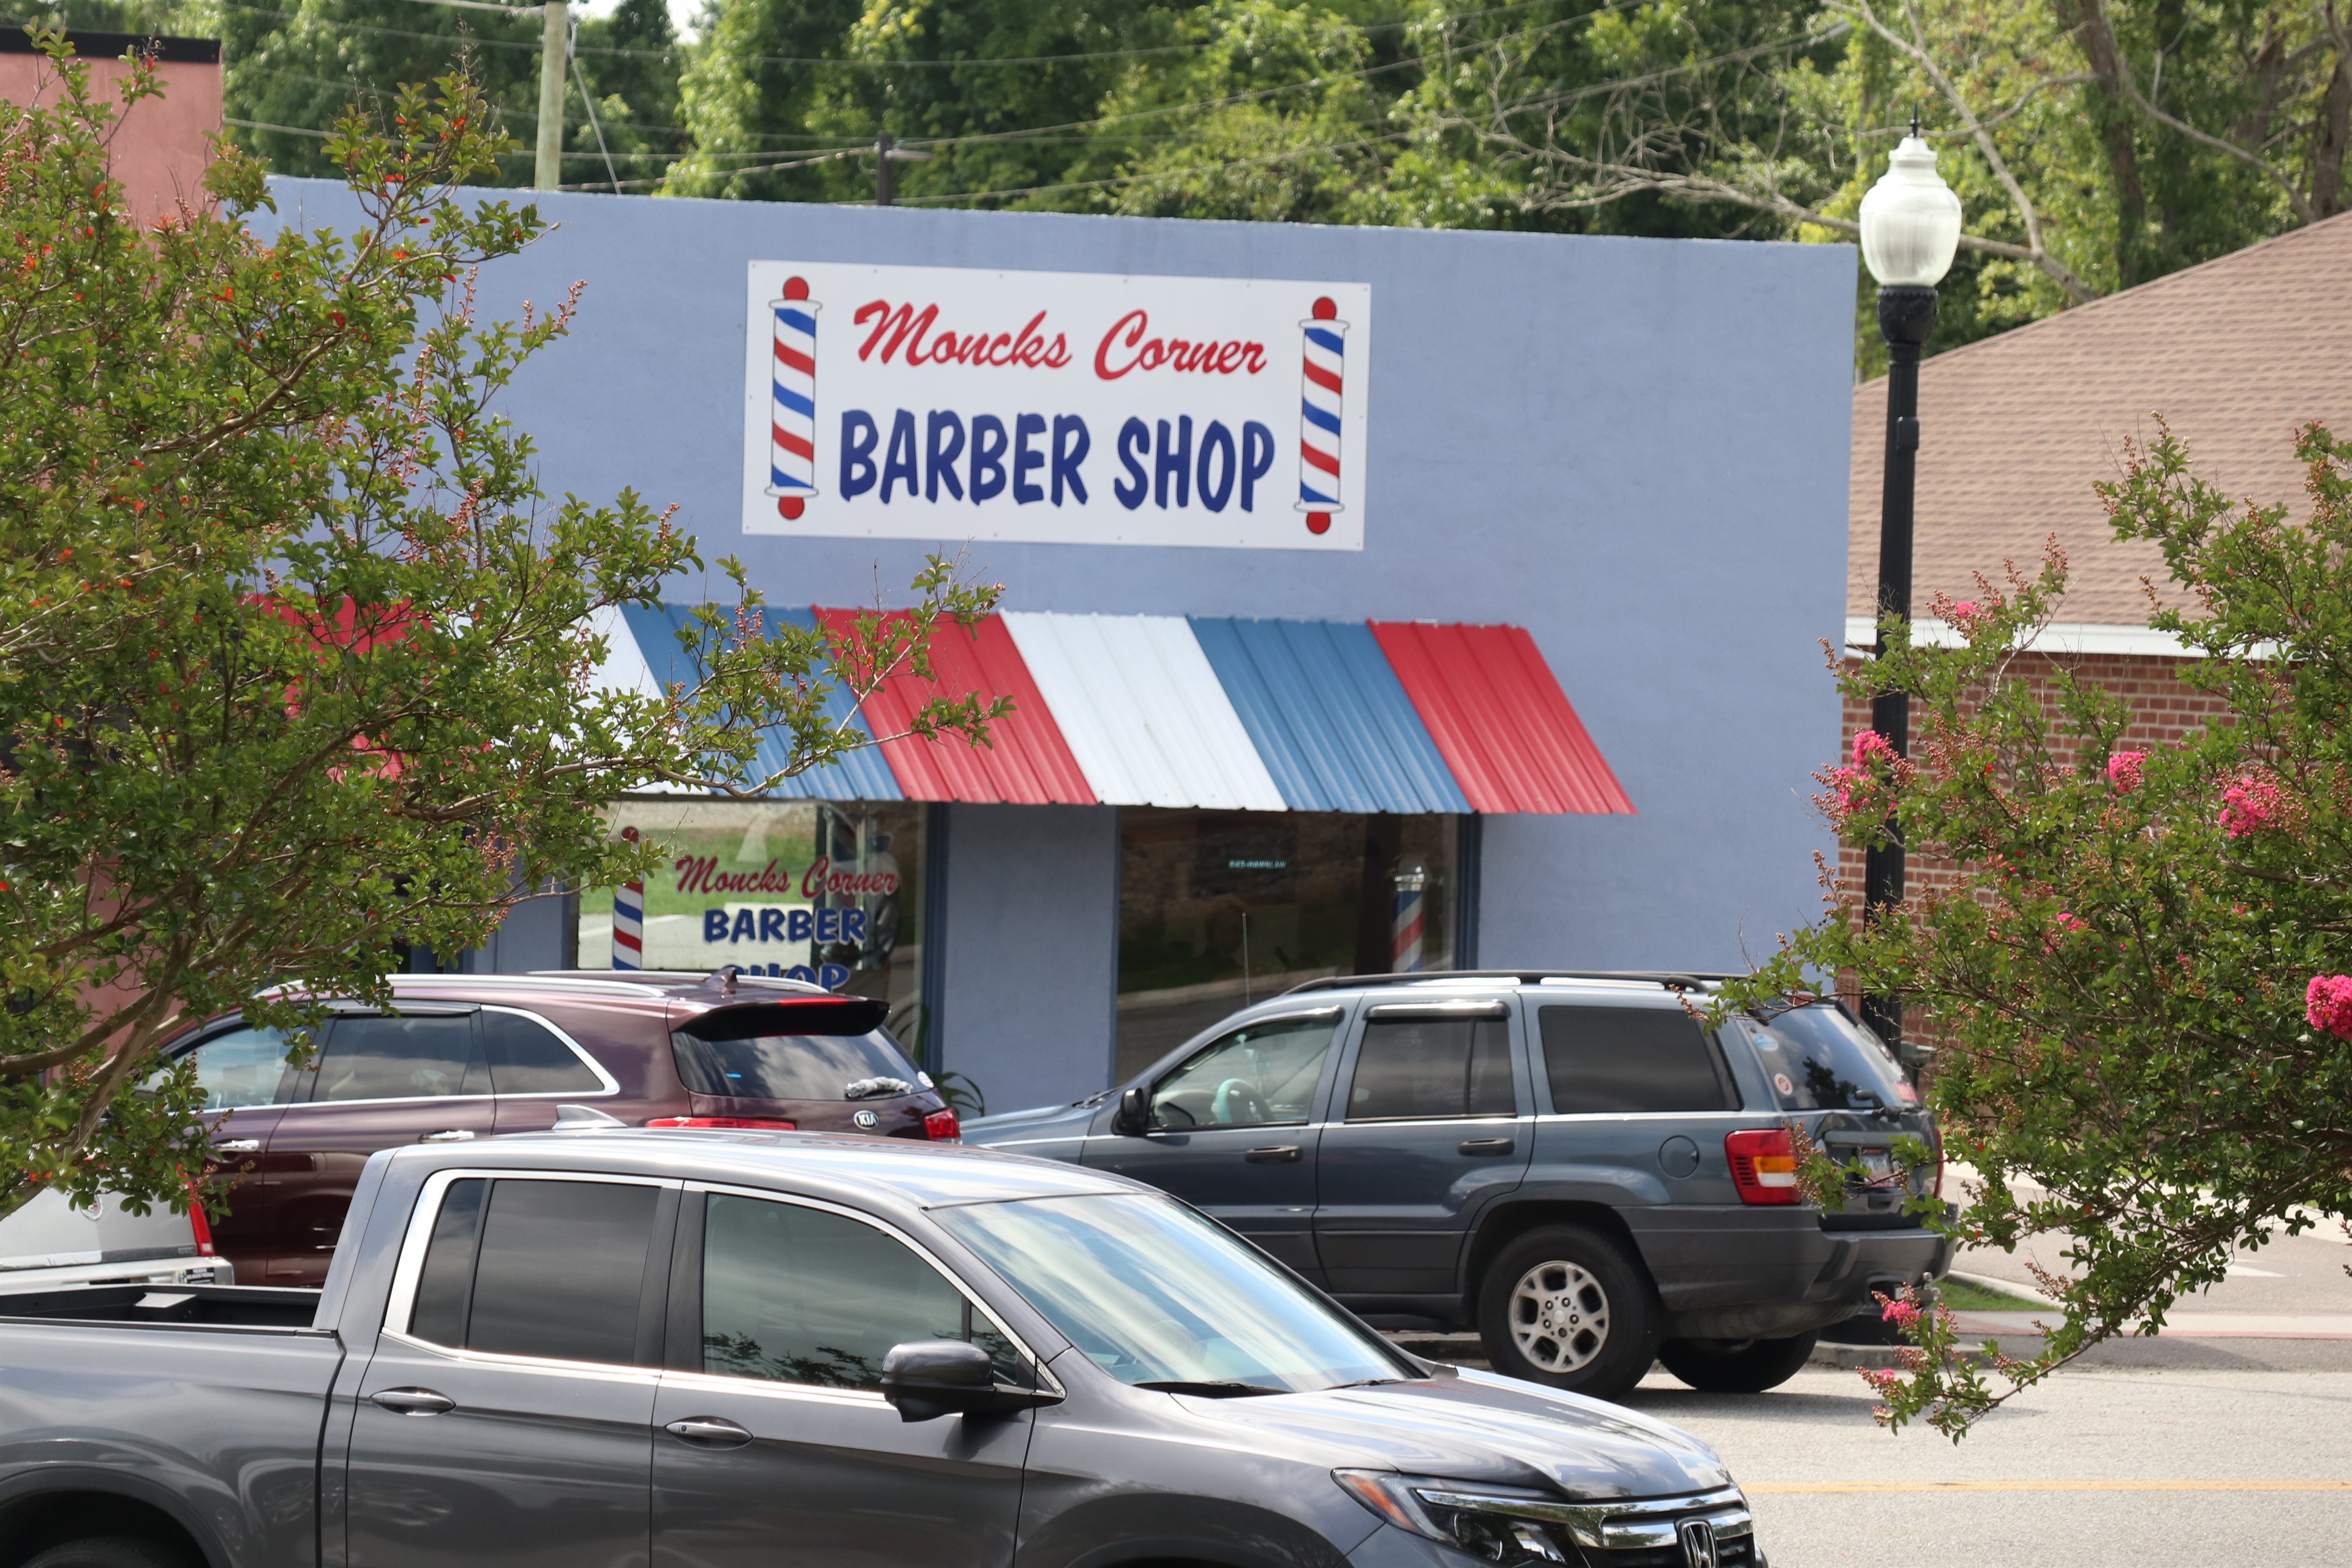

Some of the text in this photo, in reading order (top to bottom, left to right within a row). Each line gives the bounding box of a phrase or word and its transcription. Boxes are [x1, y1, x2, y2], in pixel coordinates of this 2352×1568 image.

[854, 300, 1267, 381] Moncks Corner
[840, 409, 1275, 513] BARBER SHOP
[675, 855, 899, 899] Moncks Corner
[704, 909, 866, 943] BARBER
[858, 1114, 877, 1126] KIA
